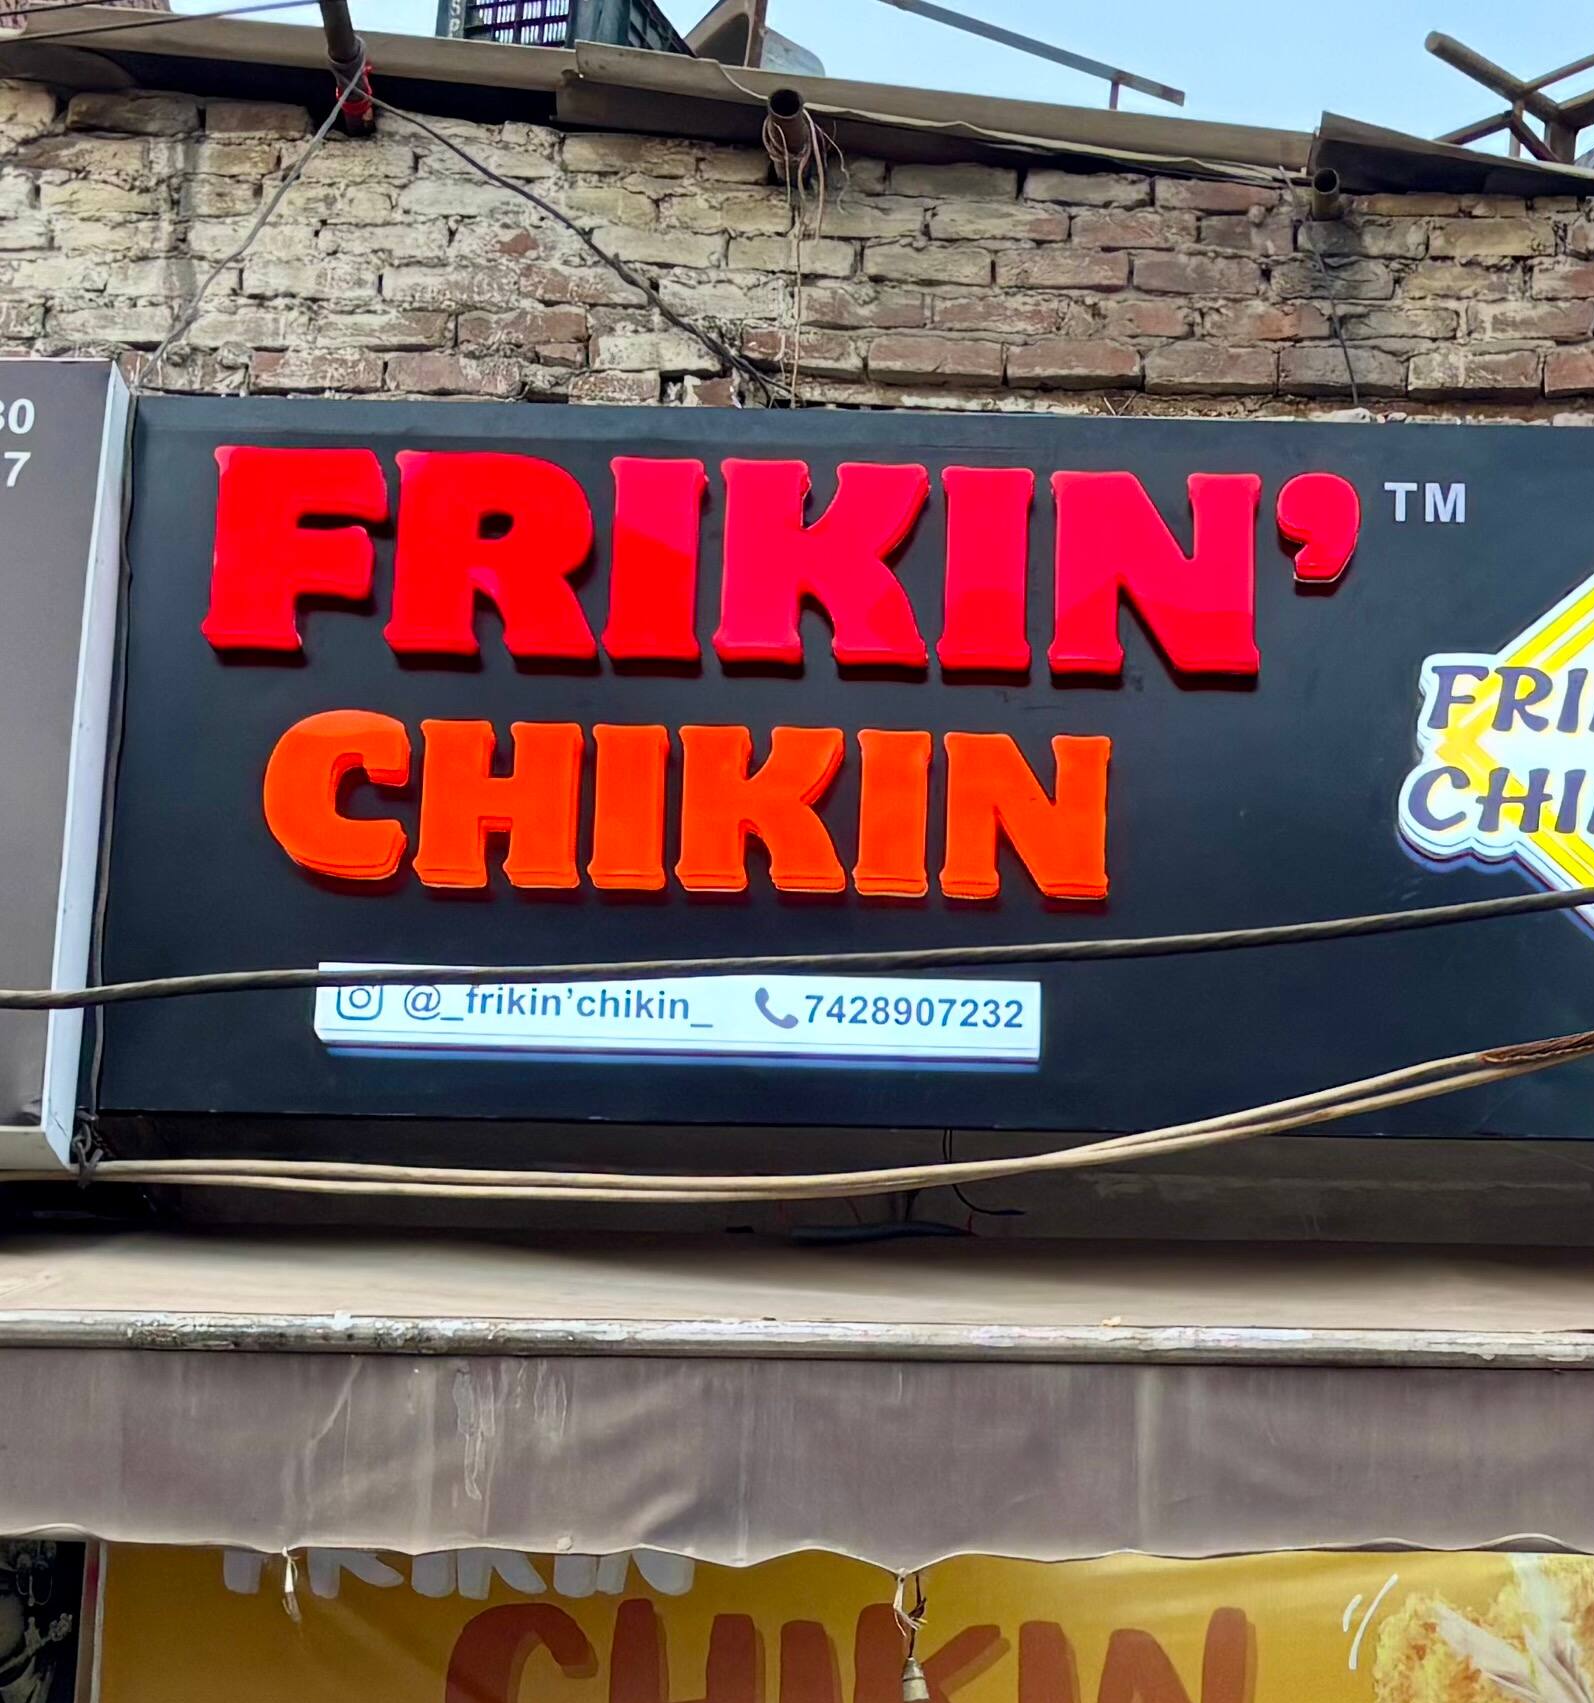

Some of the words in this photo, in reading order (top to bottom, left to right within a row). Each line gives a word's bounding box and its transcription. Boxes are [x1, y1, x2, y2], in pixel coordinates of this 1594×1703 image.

[0, 398, 35, 435] 0
[1384, 481, 1467, 523] TM
[202, 445, 1361, 676] FRIKIN'
[263, 709, 1111, 899] CHIKIN
[804, 993, 1024, 1029] 7428907232
